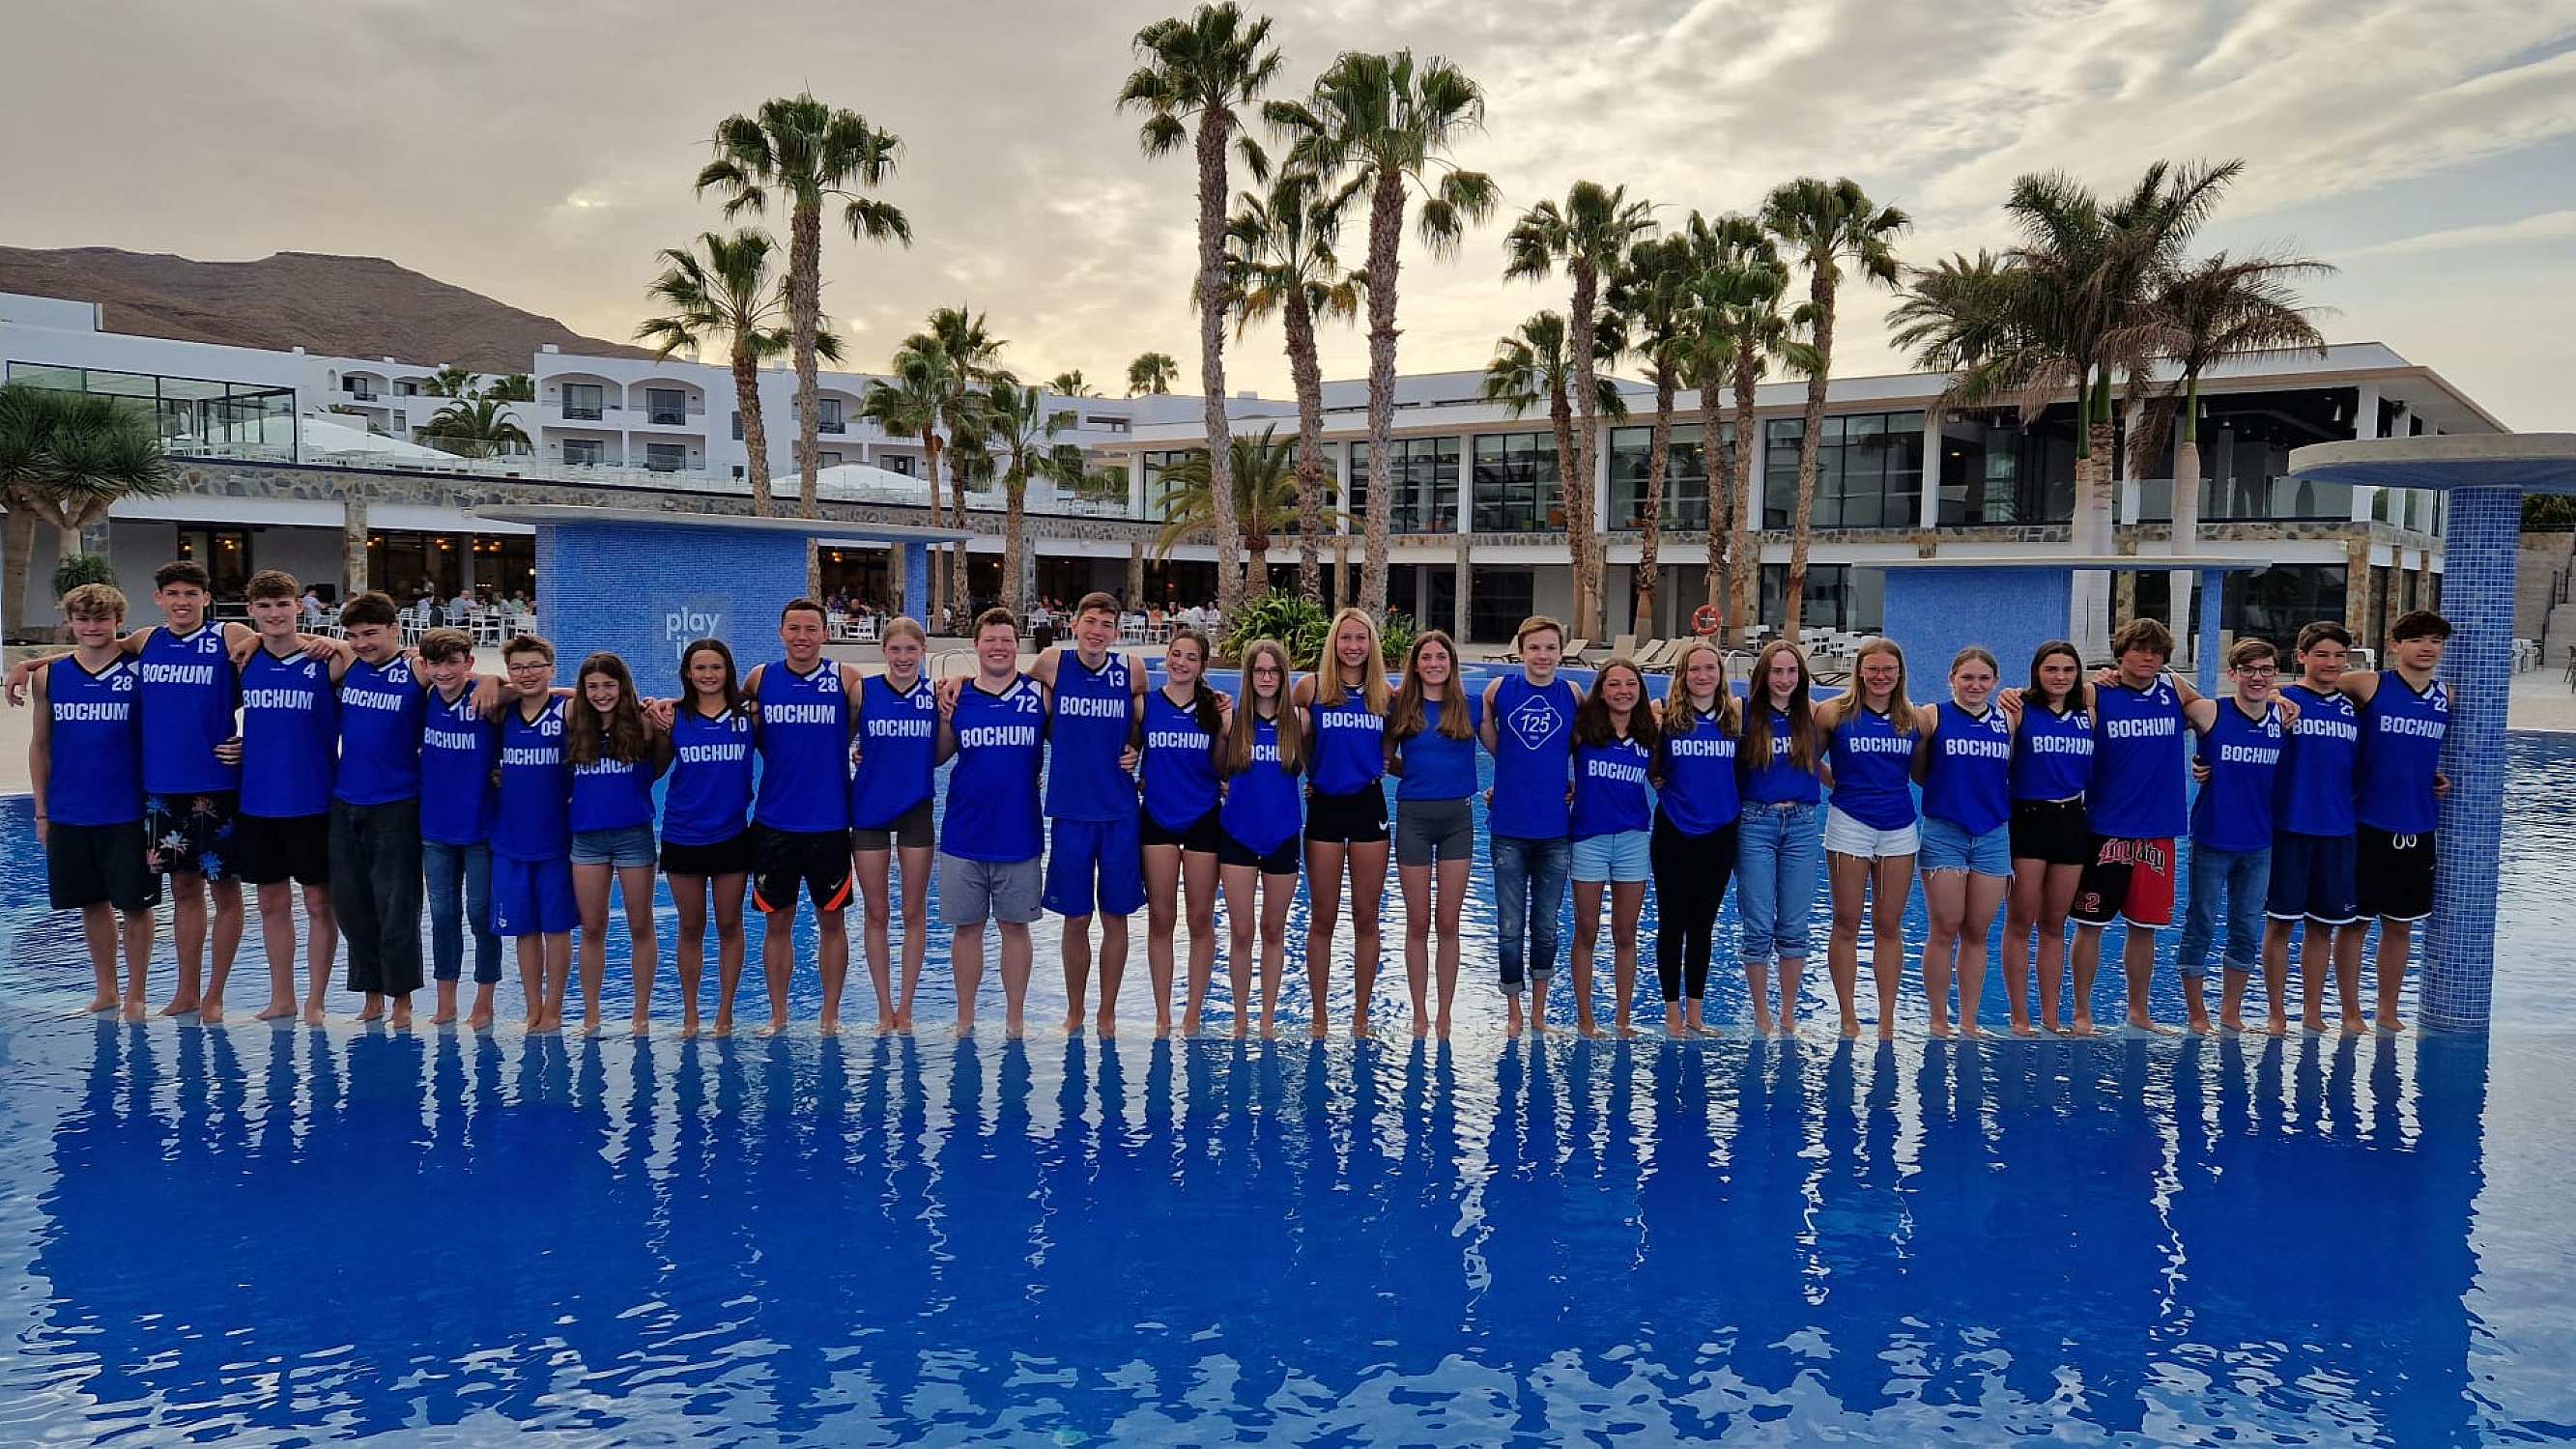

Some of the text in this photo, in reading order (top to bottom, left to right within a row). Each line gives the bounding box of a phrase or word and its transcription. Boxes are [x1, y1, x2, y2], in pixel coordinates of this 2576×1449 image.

[666, 607, 720, 640] play
[196, 639, 217, 654] 15
[143, 663, 214, 685] BOCHUM
[302, 662, 316, 678] 4
[387, 668, 408, 683] 03
[1107, 670, 1125, 687] 13
[111, 676, 133, 692] 28
[817, 677, 839, 693] 28
[242, 688, 314, 710] BOCHUM
[341, 687, 402, 712] BOCHUM
[1015, 695, 1039, 713] 72
[1059, 696, 1126, 719] BOCHUM
[2432, 696, 2448, 713] 22
[54, 702, 129, 721] BOCHUM
[764, 704, 836, 724] BOCHUM
[1322, 712, 1384, 731] BOCHUM
[541, 720, 561, 736] 09
[730, 716, 748, 732] 10
[868, 720, 931, 738] BOCHUM
[1520, 712, 1551, 732] 125
[2106, 717, 2175, 738] BOCHUM
[2293, 719, 2358, 742] BOCHUM
[2380, 715, 2447, 739] BOCHUM
[960, 725, 1035, 749] BOCHUM
[1148, 731, 1210, 751] BOCHUM
[1849, 737, 1913, 756] BOCHUM
[2032, 735, 2095, 756] BOCHUM
[679, 743, 746, 763] BOCHUM
[1672, 739, 1735, 758] BOCHUM
[1946, 739, 2010, 759] BOCHUM
[2220, 745, 2280, 765] BOCHUM
[1589, 758, 1646, 783] BOCHUM
